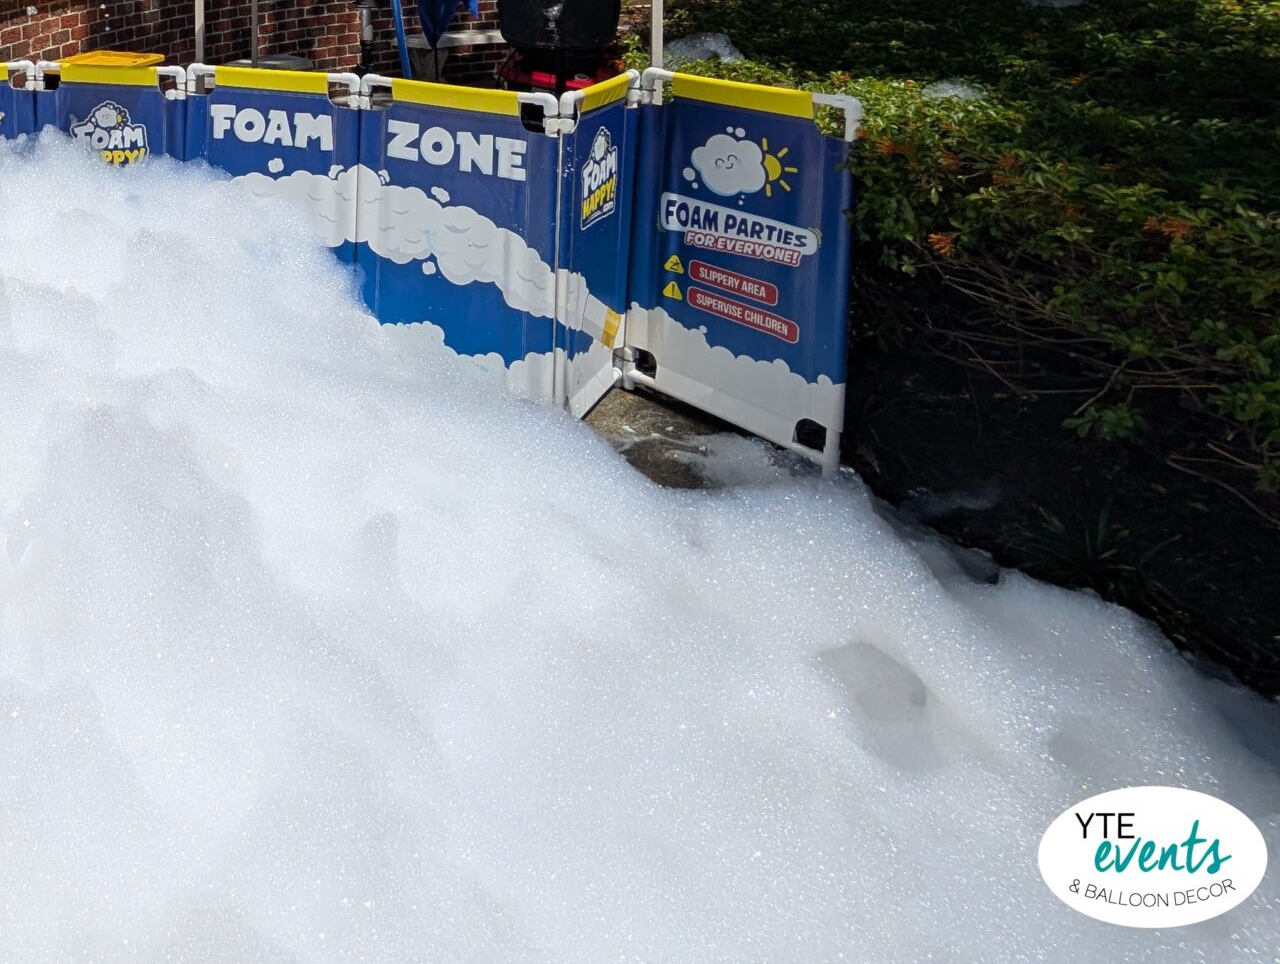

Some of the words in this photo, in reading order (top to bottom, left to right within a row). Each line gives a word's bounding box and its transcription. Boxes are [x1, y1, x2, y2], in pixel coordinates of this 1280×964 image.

[210, 104, 334, 151] FOAM
[387, 119, 526, 181] ZONE
[583, 151, 616, 199] FOAM
[583, 174, 616, 219] HAPPY!
[665, 199, 719, 233] FOAM
[724, 214, 808, 248] PARTIES
[686, 232, 714, 248] FOR
[715, 237, 800, 265] EVERYONE!
[699, 266, 740, 290] SLIPPERY
[741, 281, 766, 299] AREA
[696, 293, 743, 320] SUPERVISE
[744, 310, 788, 336] CHILDREN
